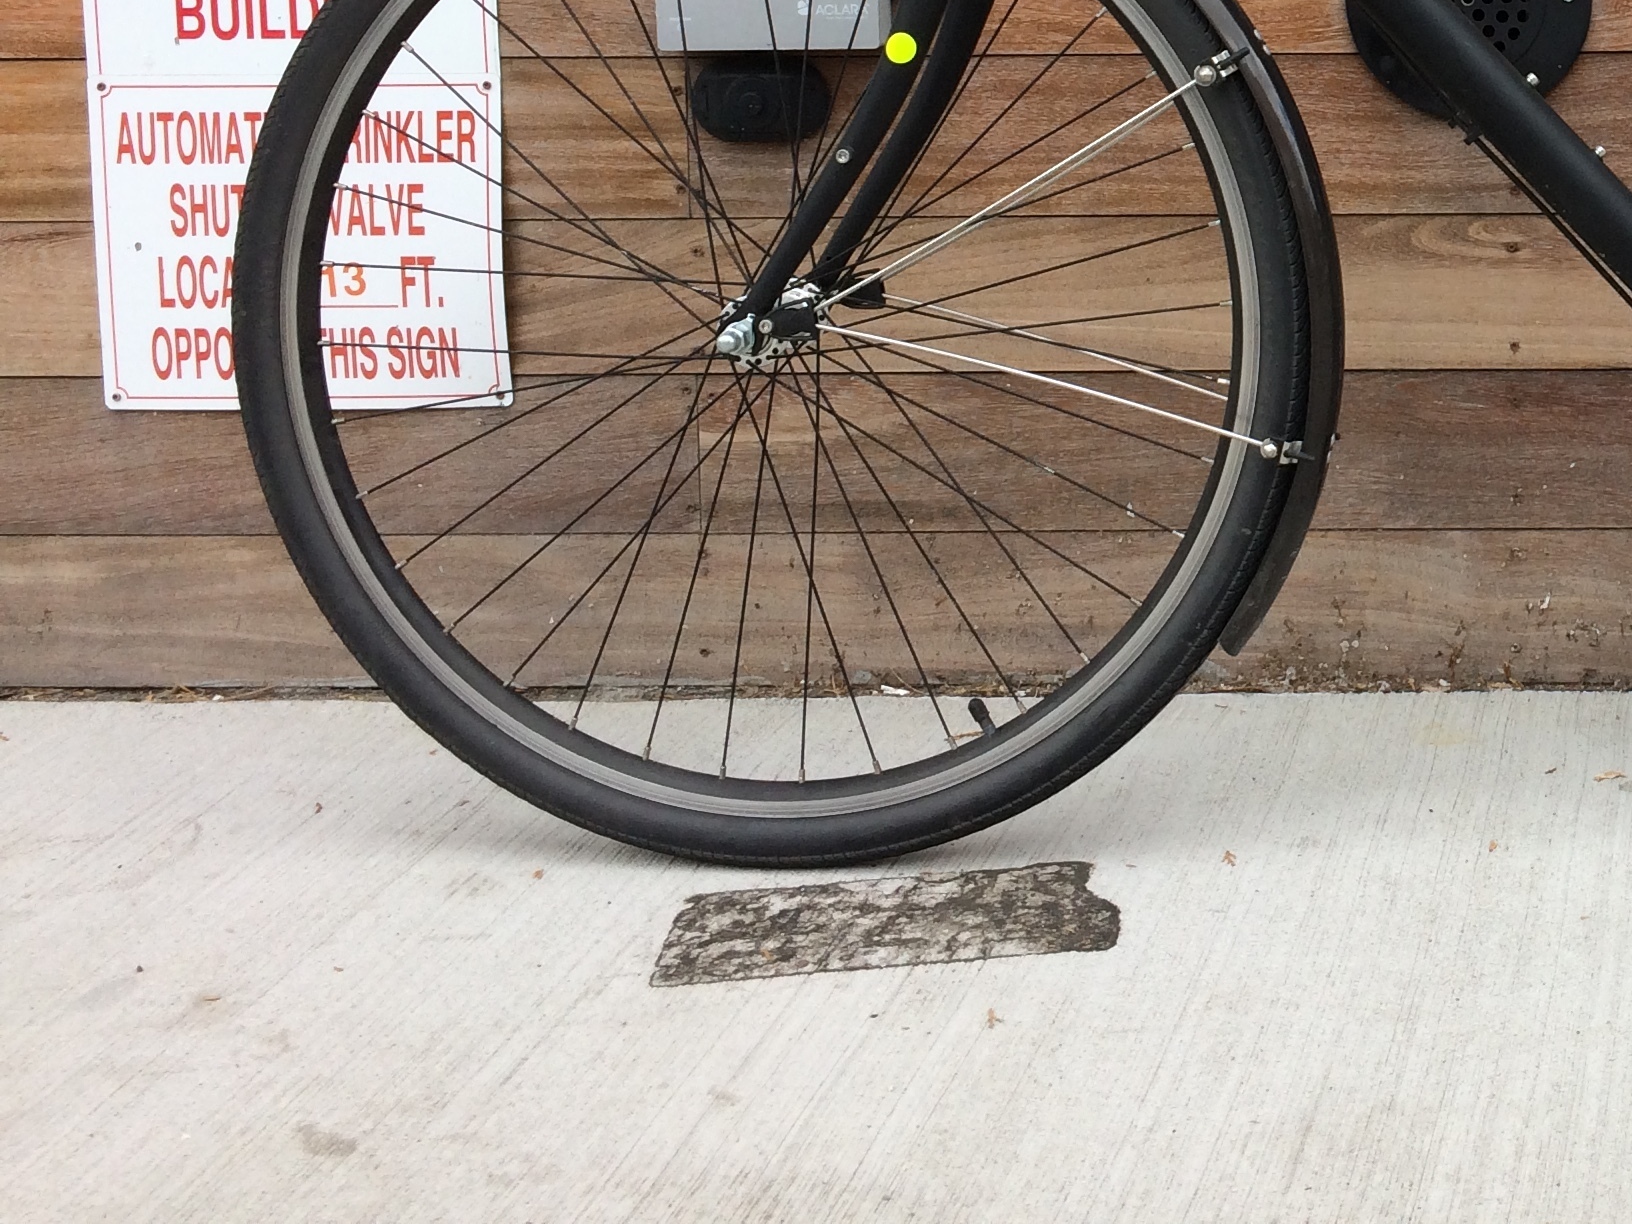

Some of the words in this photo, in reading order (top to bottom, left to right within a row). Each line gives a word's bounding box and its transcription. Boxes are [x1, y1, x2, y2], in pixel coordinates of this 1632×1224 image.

[116, 111, 268, 165] AUTOMAT
[321, 263, 367, 297] 13
[400, 255, 445, 309] FT.
[152, 326, 236, 380] OPPO
[387, 326, 461, 380] SIGN
